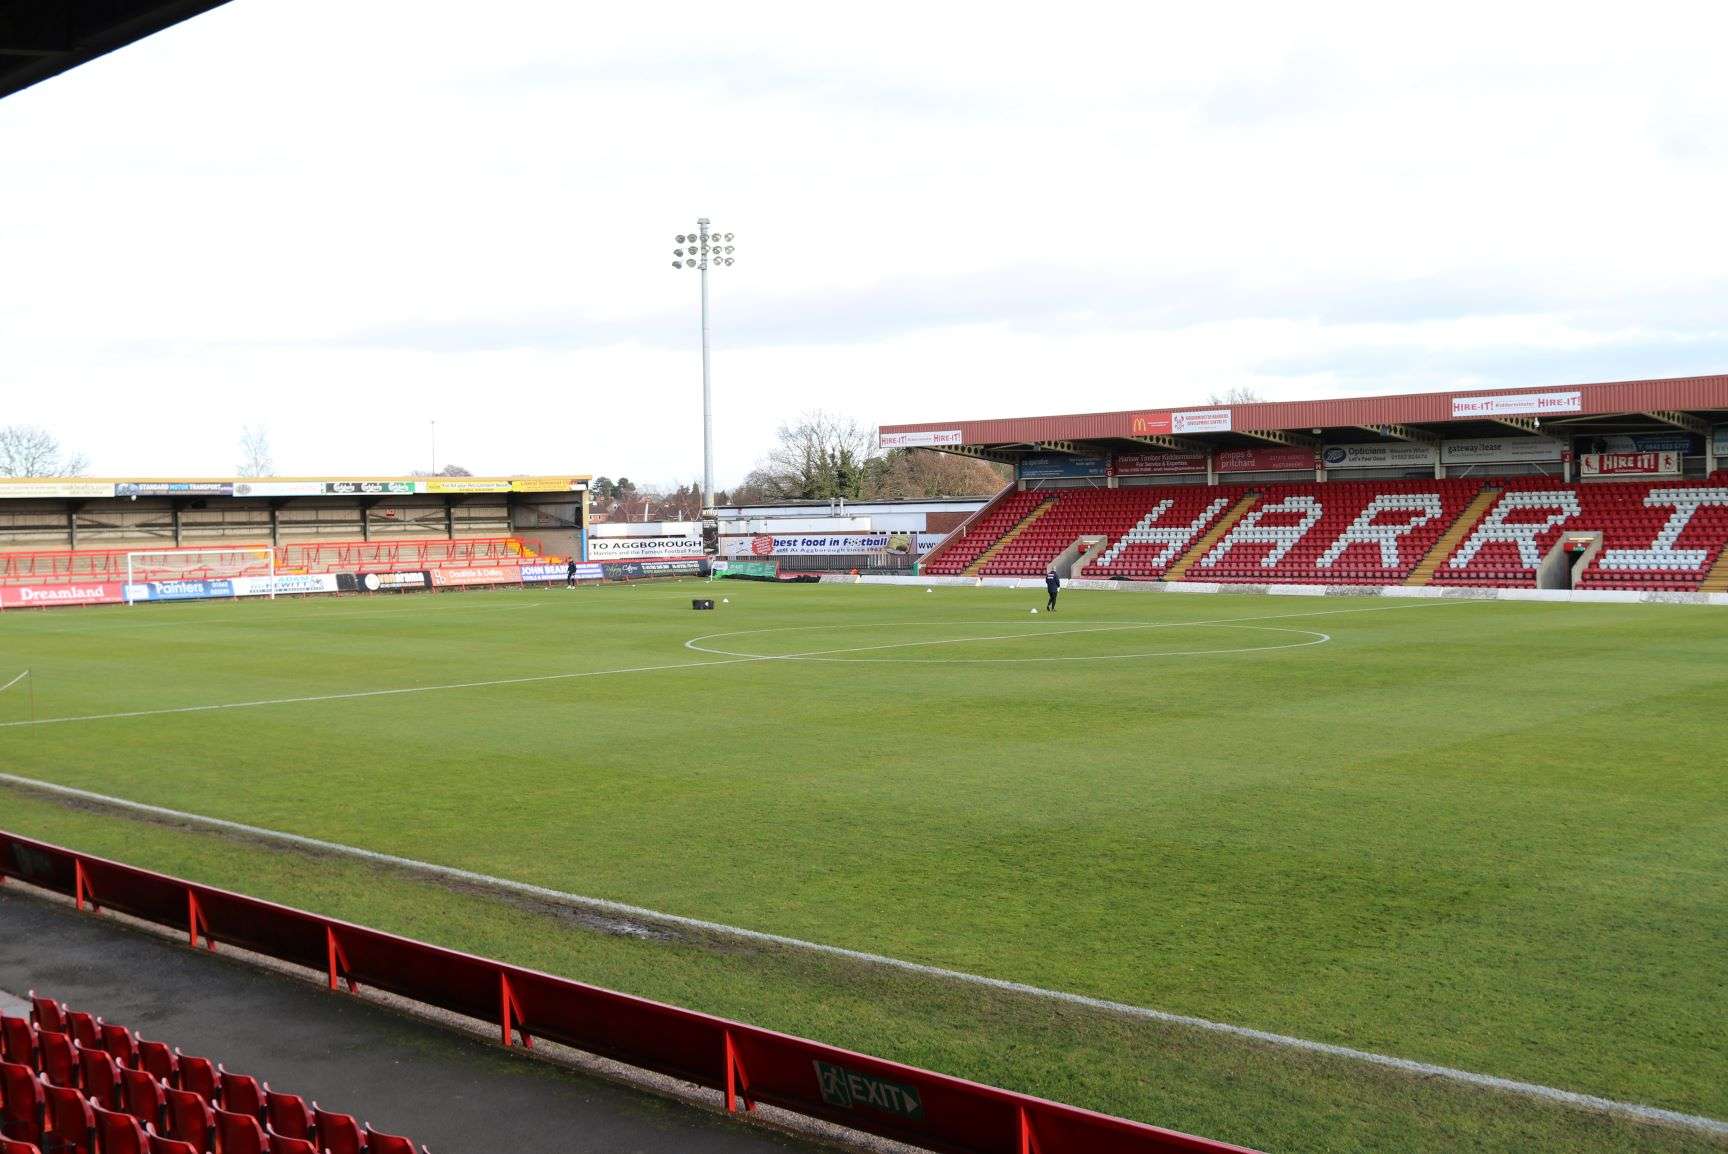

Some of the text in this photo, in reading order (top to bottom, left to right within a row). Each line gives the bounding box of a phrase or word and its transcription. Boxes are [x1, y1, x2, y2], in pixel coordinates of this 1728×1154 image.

[1453, 401, 1494, 412] HIRE-IT!
[1537, 397, 1582, 408] HIRE-IT!
[1348, 447, 1386, 456] Opticians
[1603, 454, 1655, 470] HIRE IT!
[612, 540, 702, 549] AGGBOROUGH
[772, 538, 798, 547] best
[801, 538, 826, 547] food
[829, 538, 840, 546] in
[843, 537, 888, 547] football
[21, 585, 105, 600] Dreamland
[849, 1074, 901, 1111] EXIT
